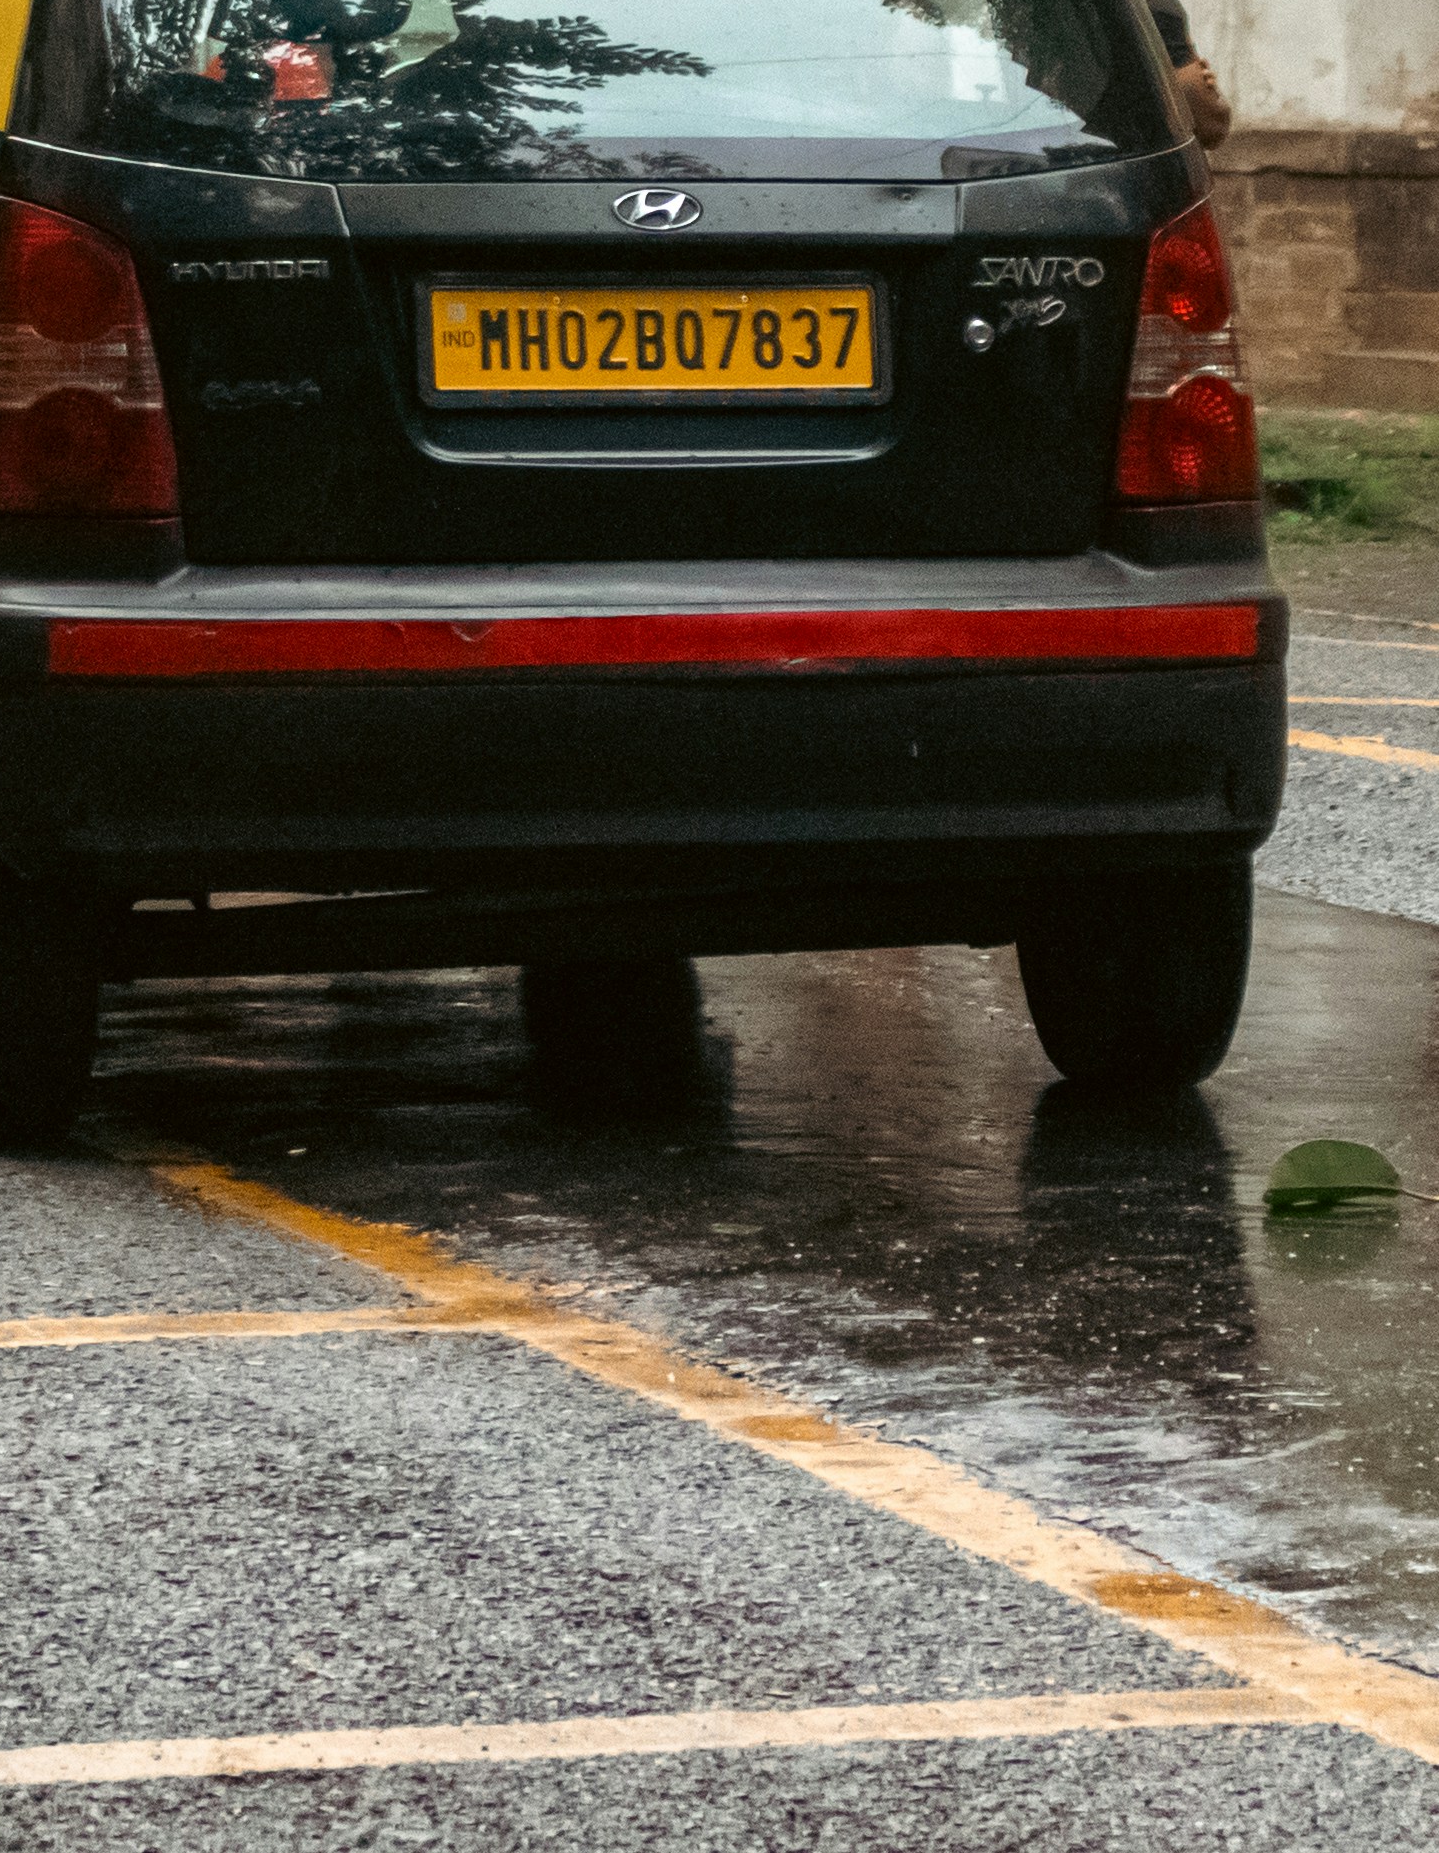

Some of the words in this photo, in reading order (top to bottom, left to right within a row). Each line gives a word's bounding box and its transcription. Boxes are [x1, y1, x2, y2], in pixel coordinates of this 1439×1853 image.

[168, 259, 330, 282] HYUNDAI
[972, 257, 1105, 287] SANTRO
[442, 330, 475, 349] IND
[478, 306, 861, 371] MH02BQ7837
